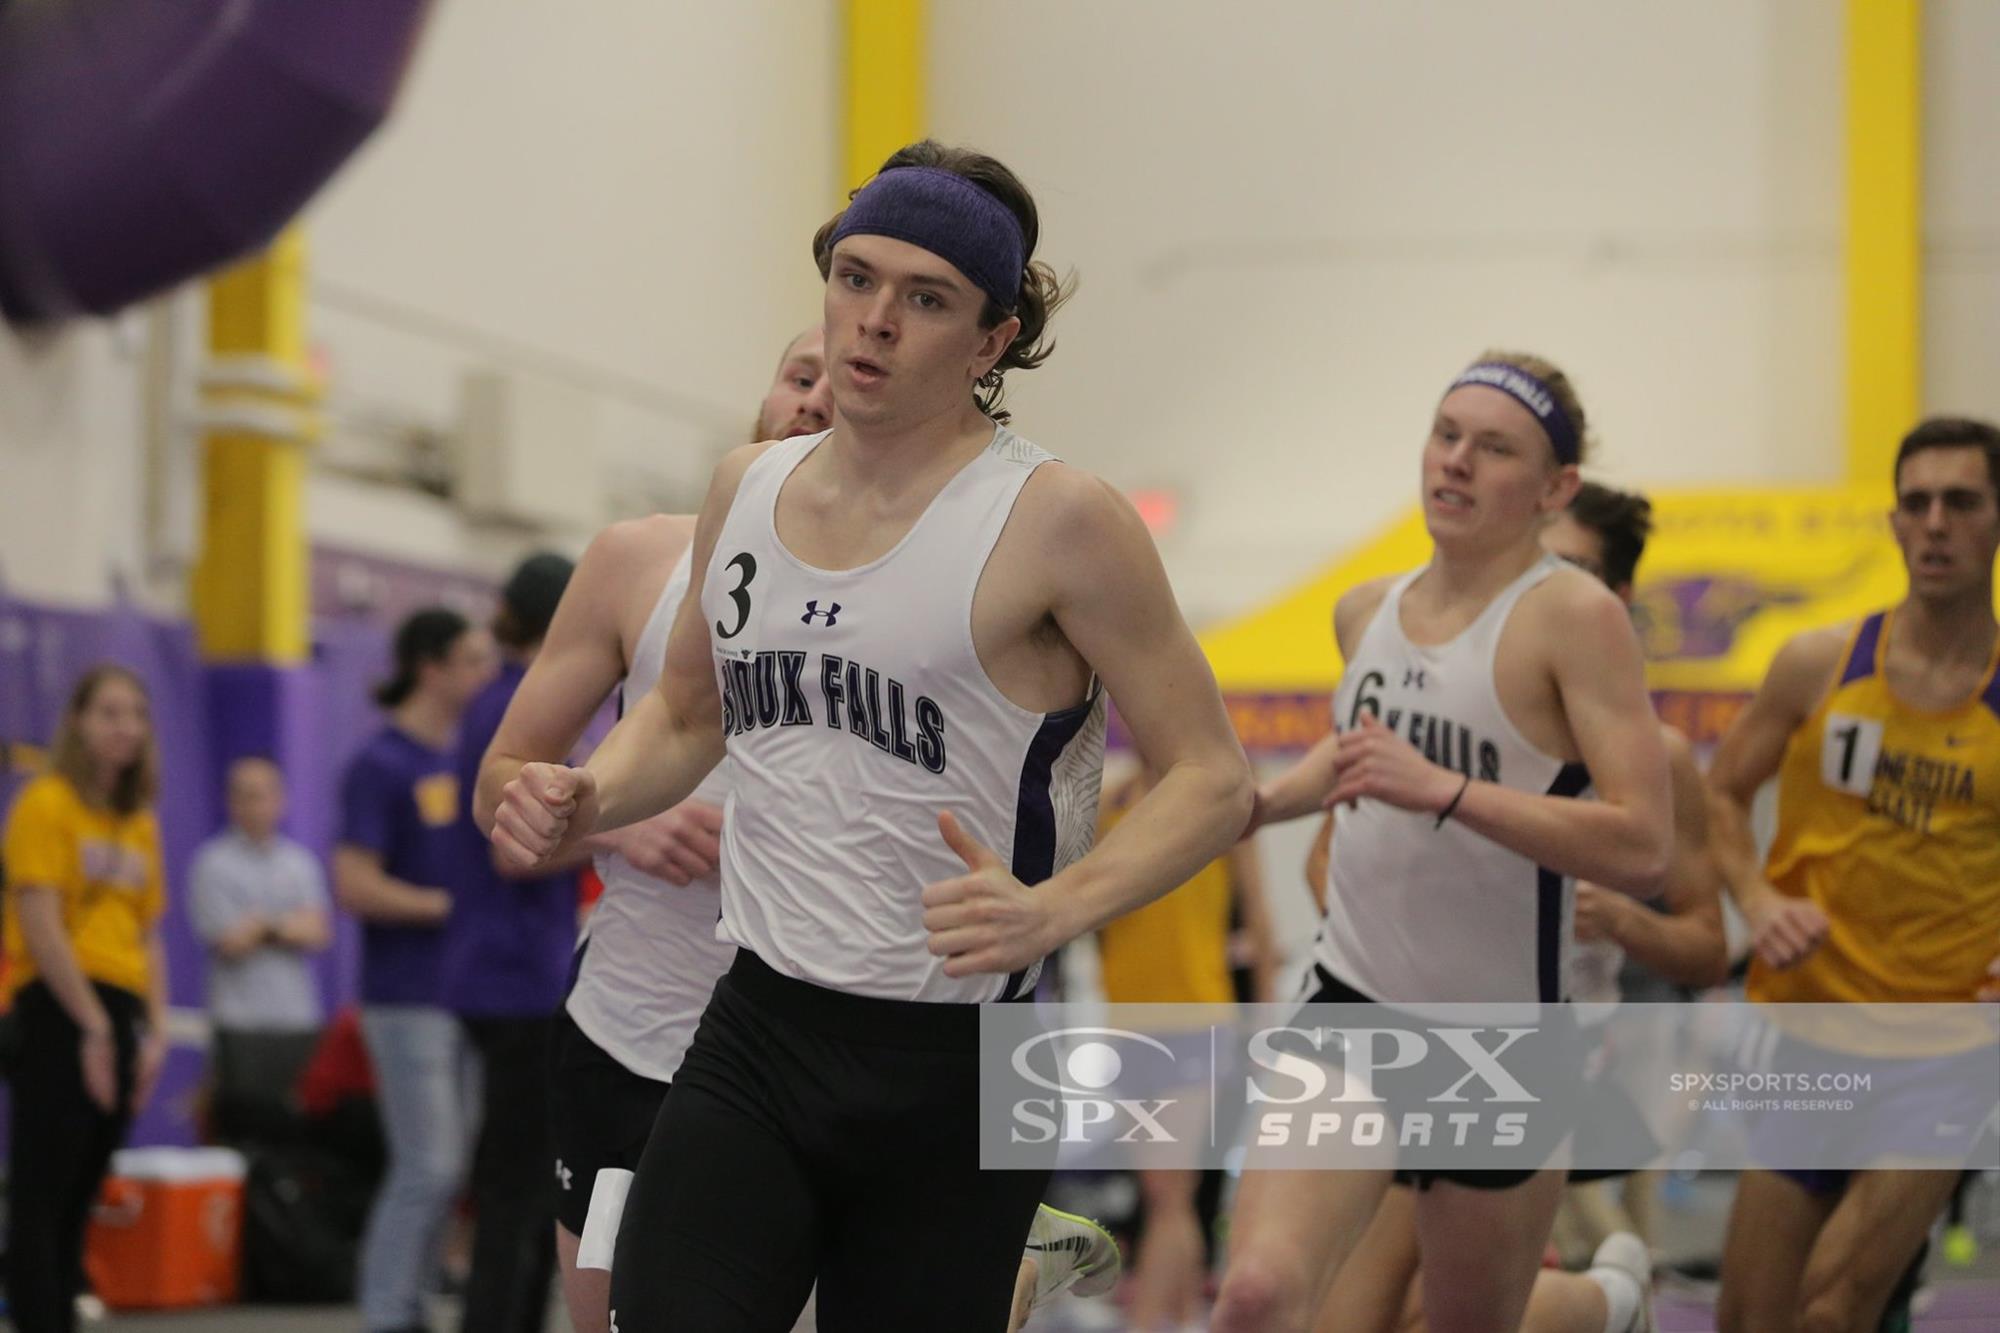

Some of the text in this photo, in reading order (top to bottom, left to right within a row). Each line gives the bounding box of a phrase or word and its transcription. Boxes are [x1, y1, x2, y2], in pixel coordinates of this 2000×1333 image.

[716, 552, 757, 639] 3
[821, 653, 946, 774] FALLS
[1350, 672, 1384, 728] 6
[1835, 723, 1860, 786] 1
